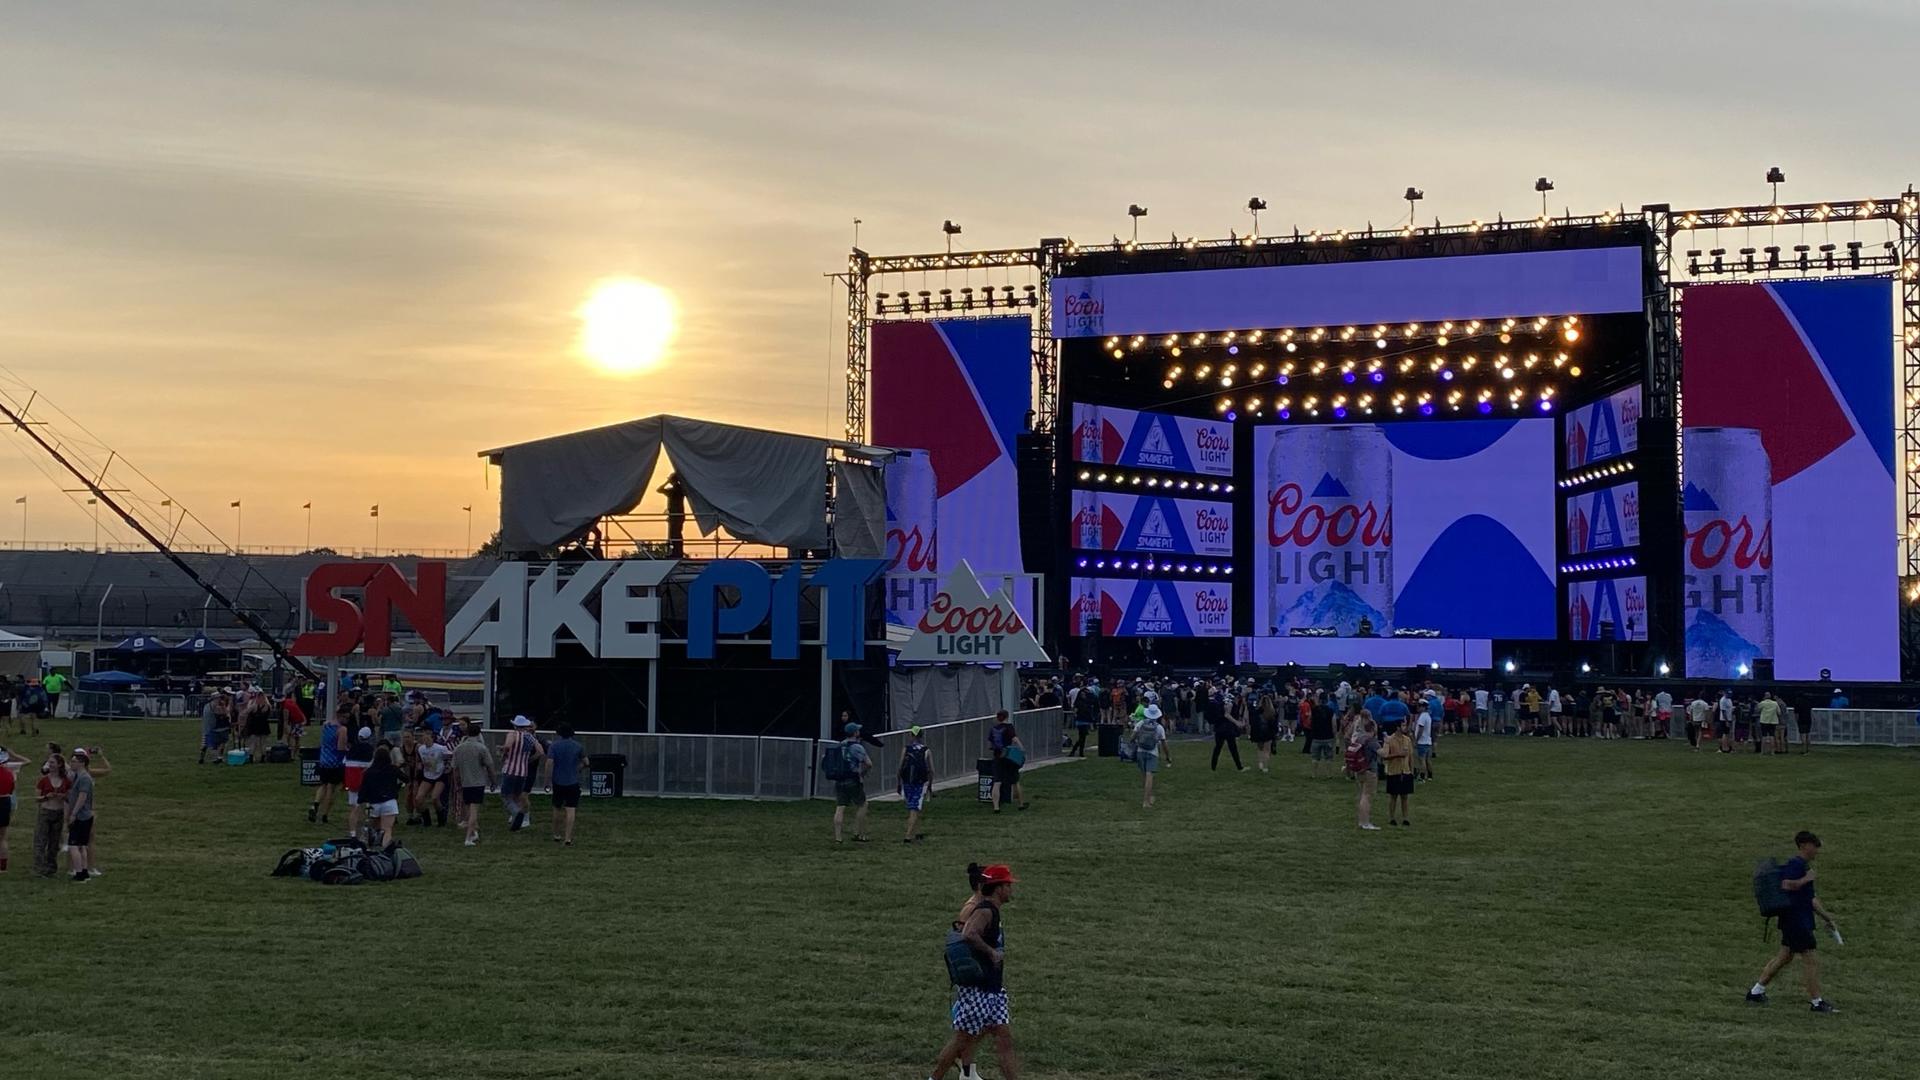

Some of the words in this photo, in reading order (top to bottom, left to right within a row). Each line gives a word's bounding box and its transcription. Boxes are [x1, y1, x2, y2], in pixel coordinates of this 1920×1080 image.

[1067, 316, 1103, 328] LIGHT
[1196, 428, 1230, 450] Coors
[1200, 451, 1226, 463] LIGHT
[1196, 509, 1229, 531] Coors
[1200, 532, 1226, 543] LIGHT
[1276, 551, 1387, 585] LIGHT
[288, 560, 679, 659] SNAKE
[687, 559, 893, 660] PIT
[1195, 590, 1229, 613] Coors
[918, 592, 1024, 634] Coors
[1199, 613, 1225, 624] LIGHT
[937, 635, 1004, 654] LIGHT
